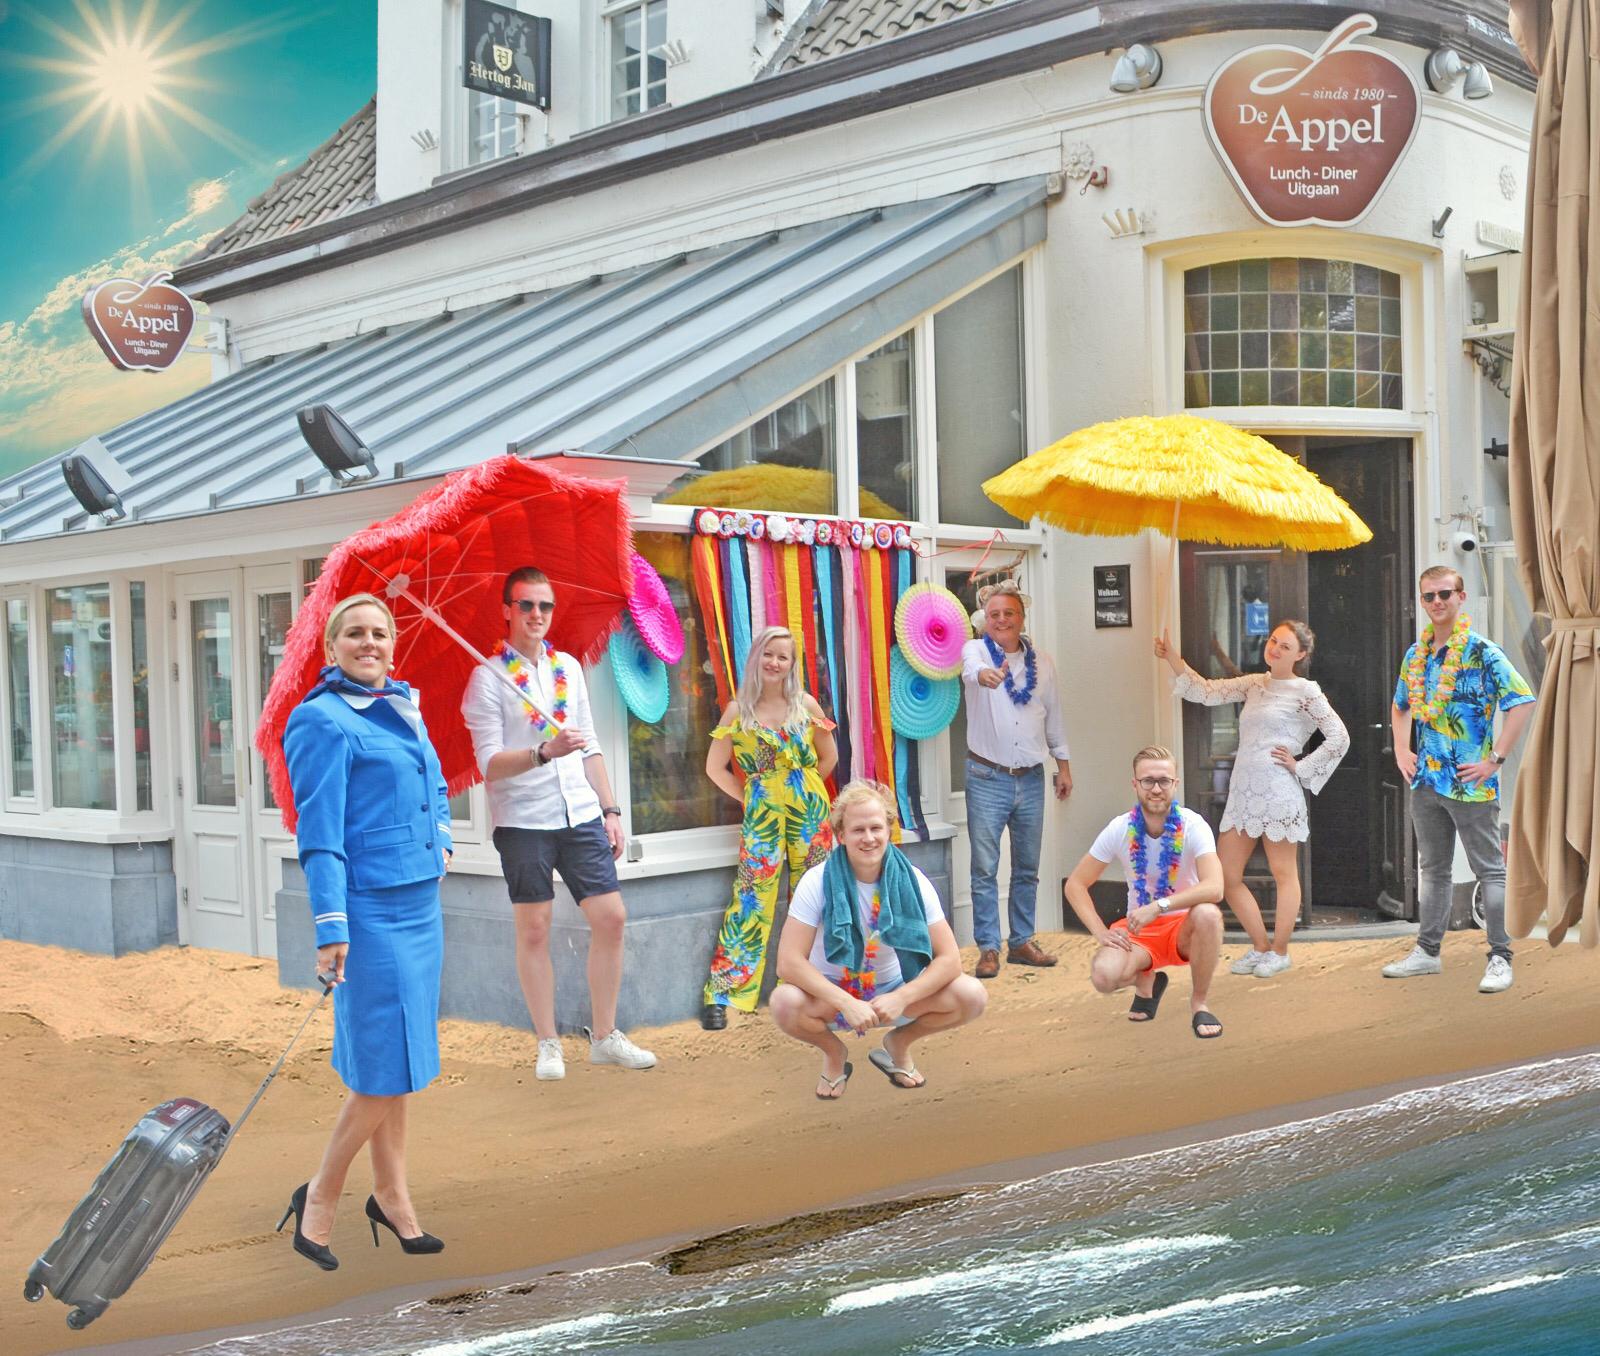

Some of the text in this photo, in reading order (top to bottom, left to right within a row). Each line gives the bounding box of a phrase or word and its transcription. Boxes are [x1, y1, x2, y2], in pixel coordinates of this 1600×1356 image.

[469, 61, 536, 93] Hertog Jan
[1312, 87, 1349, 100] sinds
[1353, 87, 1385, 100] 1980
[1239, 103, 1385, 152] De Appel
[1270, 166, 1311, 180] Lunch
[1321, 166, 1358, 180] Diner
[1288, 182, 1339, 197] Uitgaan
[108, 307, 180, 334] De Appel
[124, 338, 145, 347] Lunch
[150, 340, 168, 349] Diner
[134, 347, 160, 356] Uitgaan
